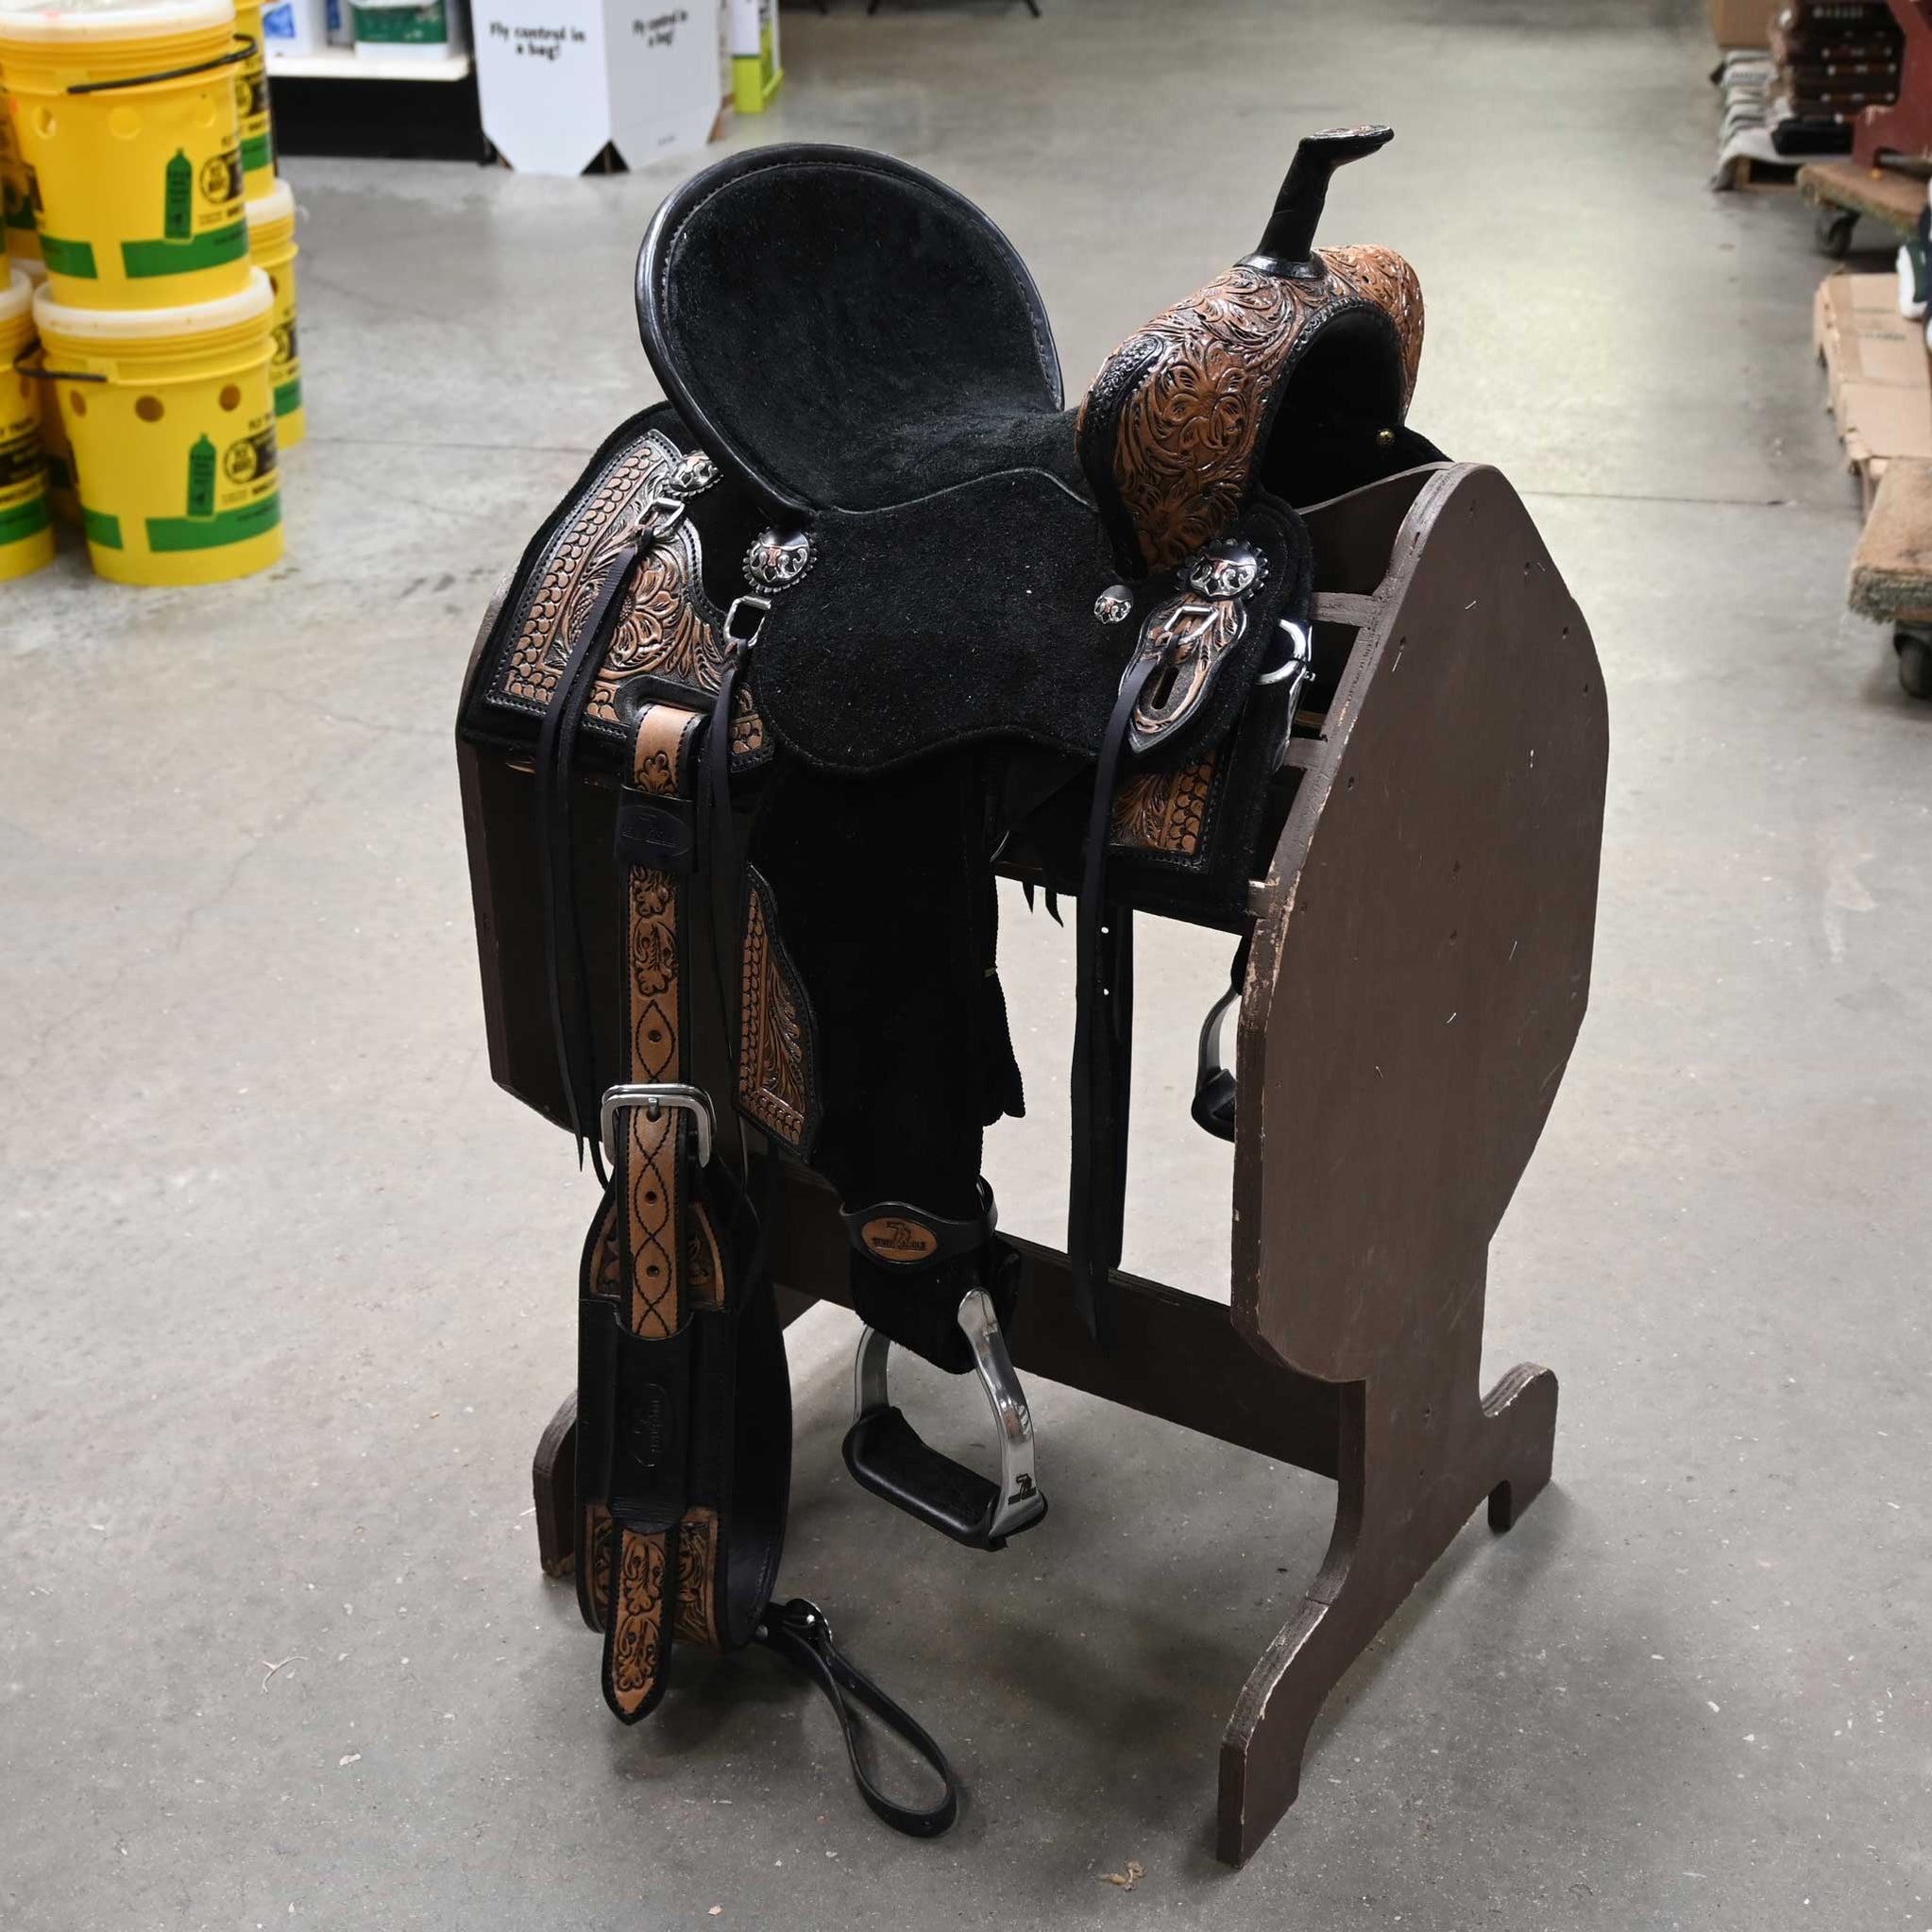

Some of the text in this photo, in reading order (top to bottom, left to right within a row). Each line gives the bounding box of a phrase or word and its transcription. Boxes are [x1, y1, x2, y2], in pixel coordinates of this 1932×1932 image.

[489, 22, 585, 42] Fly control in
